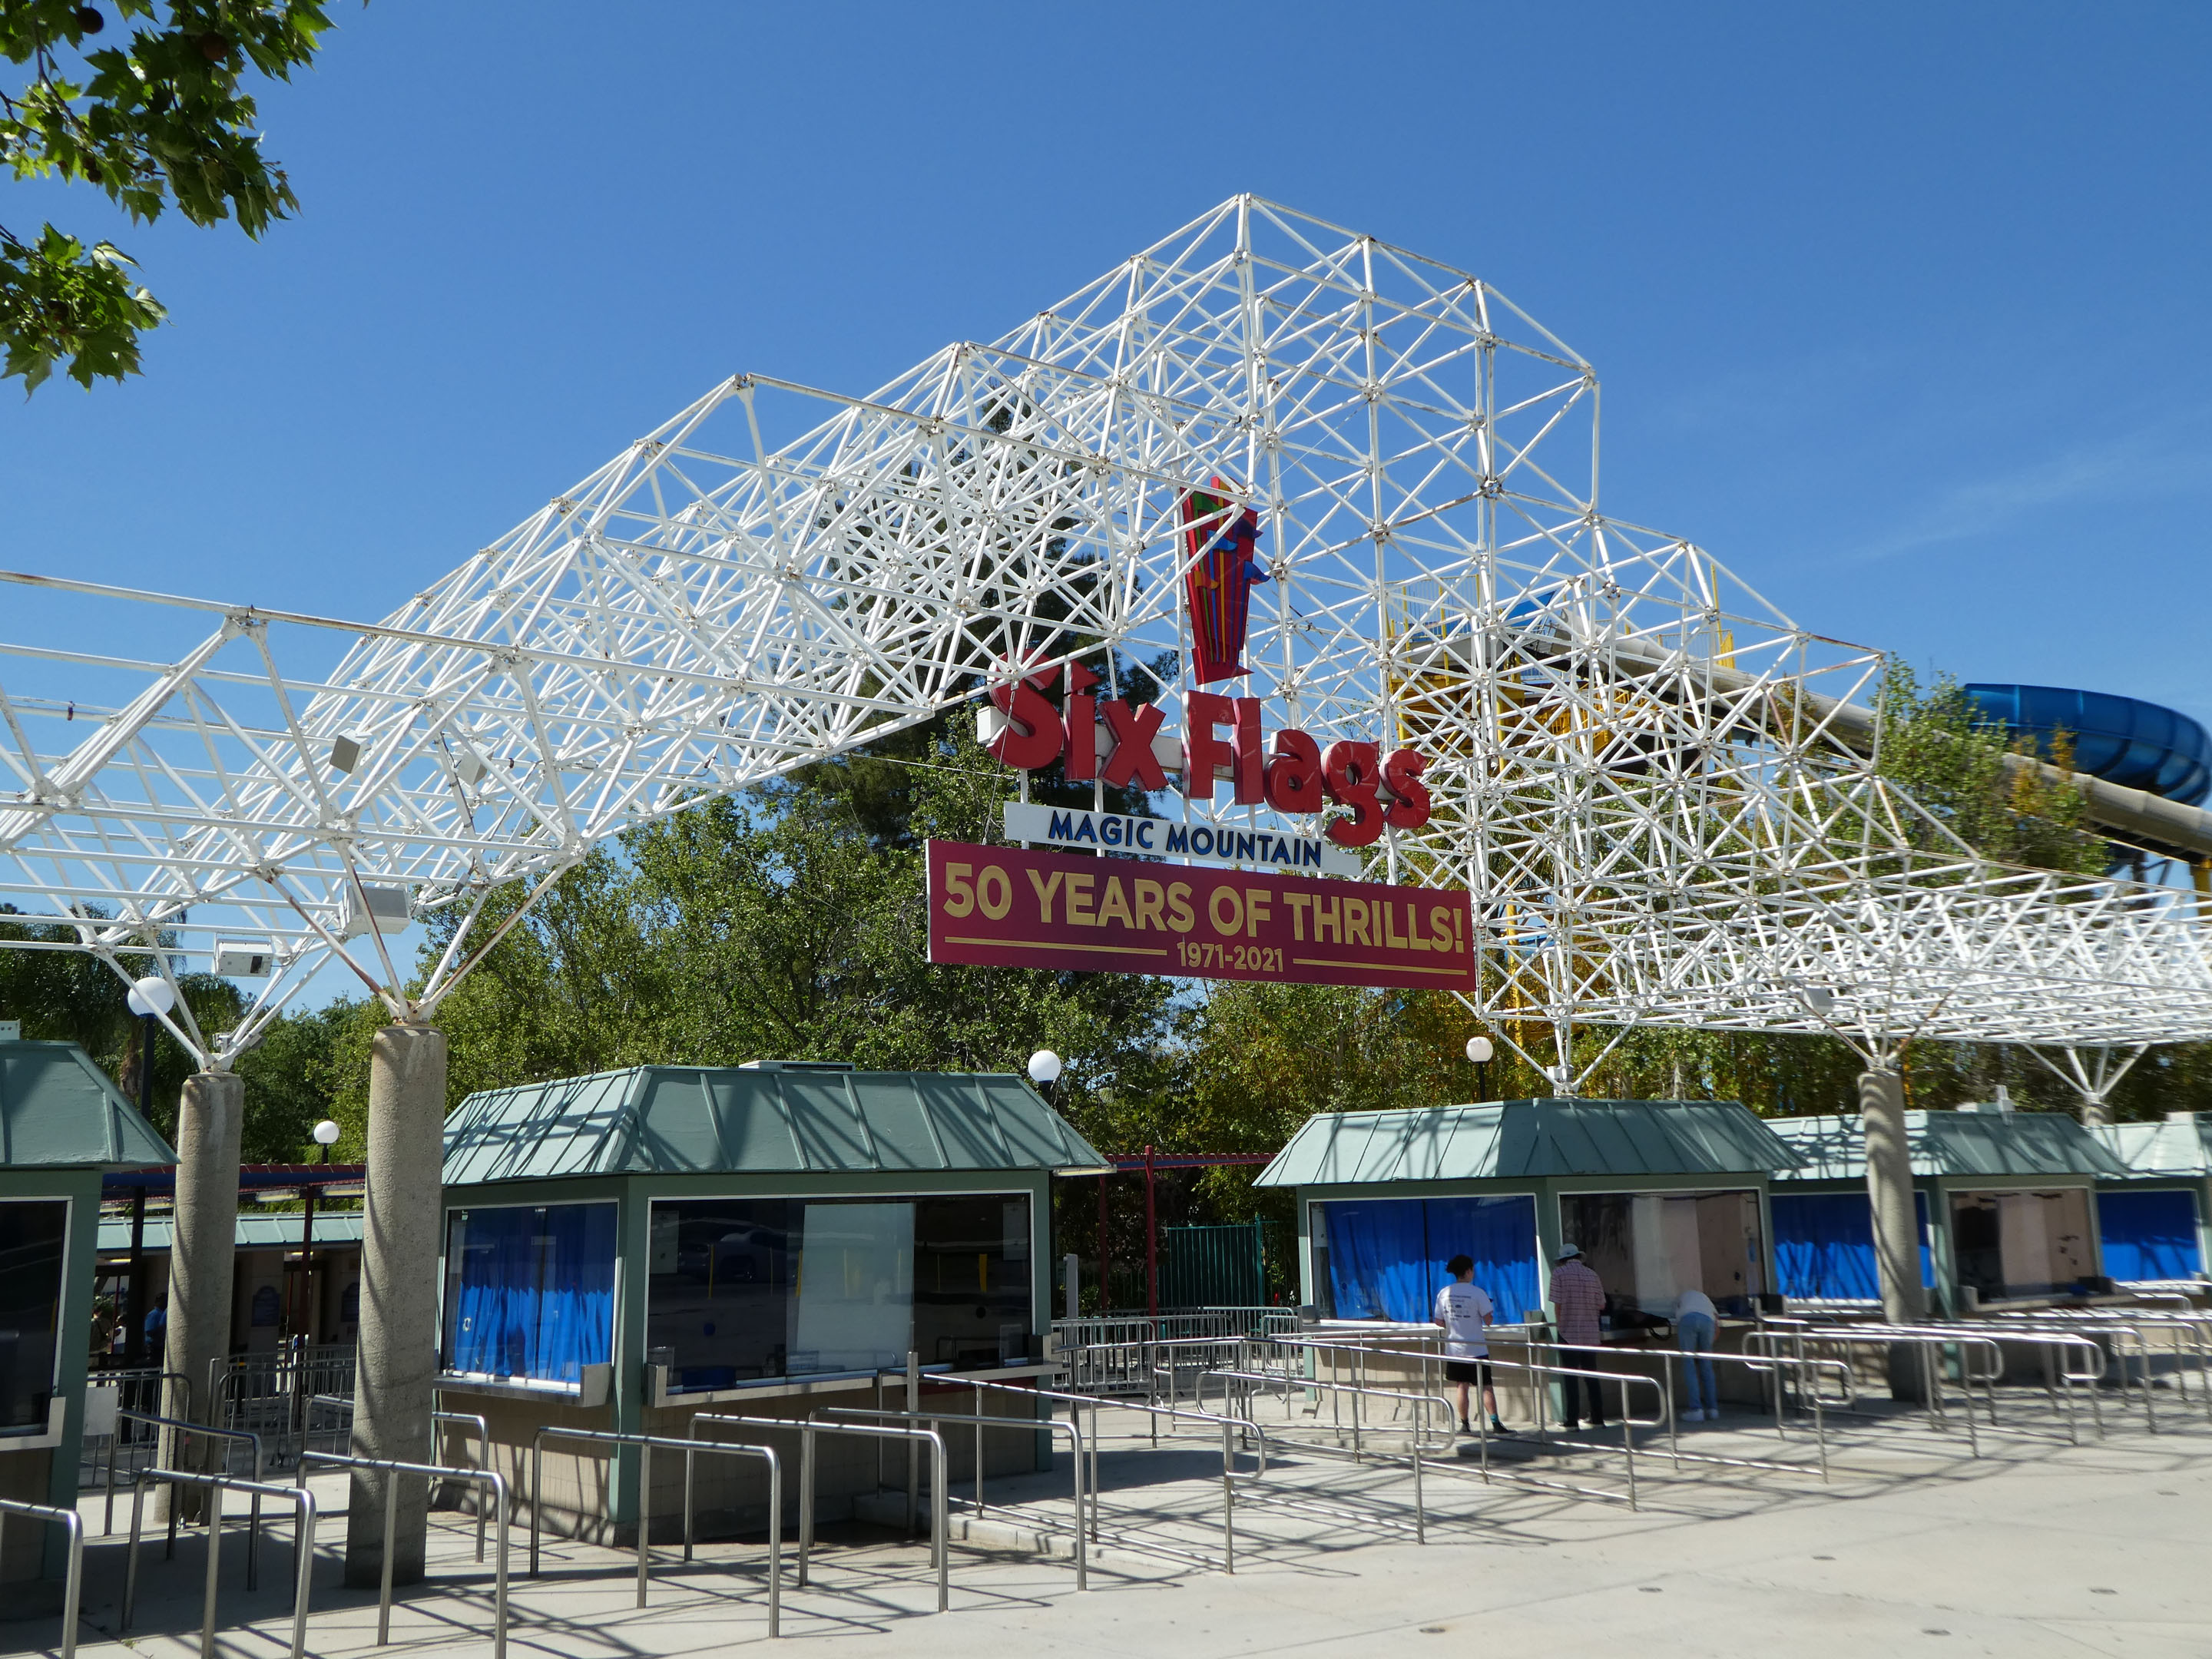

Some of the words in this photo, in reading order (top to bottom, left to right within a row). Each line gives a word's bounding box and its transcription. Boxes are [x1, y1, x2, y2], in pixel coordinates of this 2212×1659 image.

[987, 648, 1168, 792] Six
[1183, 690, 1431, 847] Flags
[1048, 810, 1154, 849] MAGIC
[1165, 823, 1321, 868] MOUNTAIN
[943, 862, 1012, 920] 50
[1025, 869, 1195, 933] YEARS
[1208, 886, 1272, 938] OF
[1283, 892, 1465, 953] THRILLS!
[1177, 942, 1283, 972] 1971-2021
